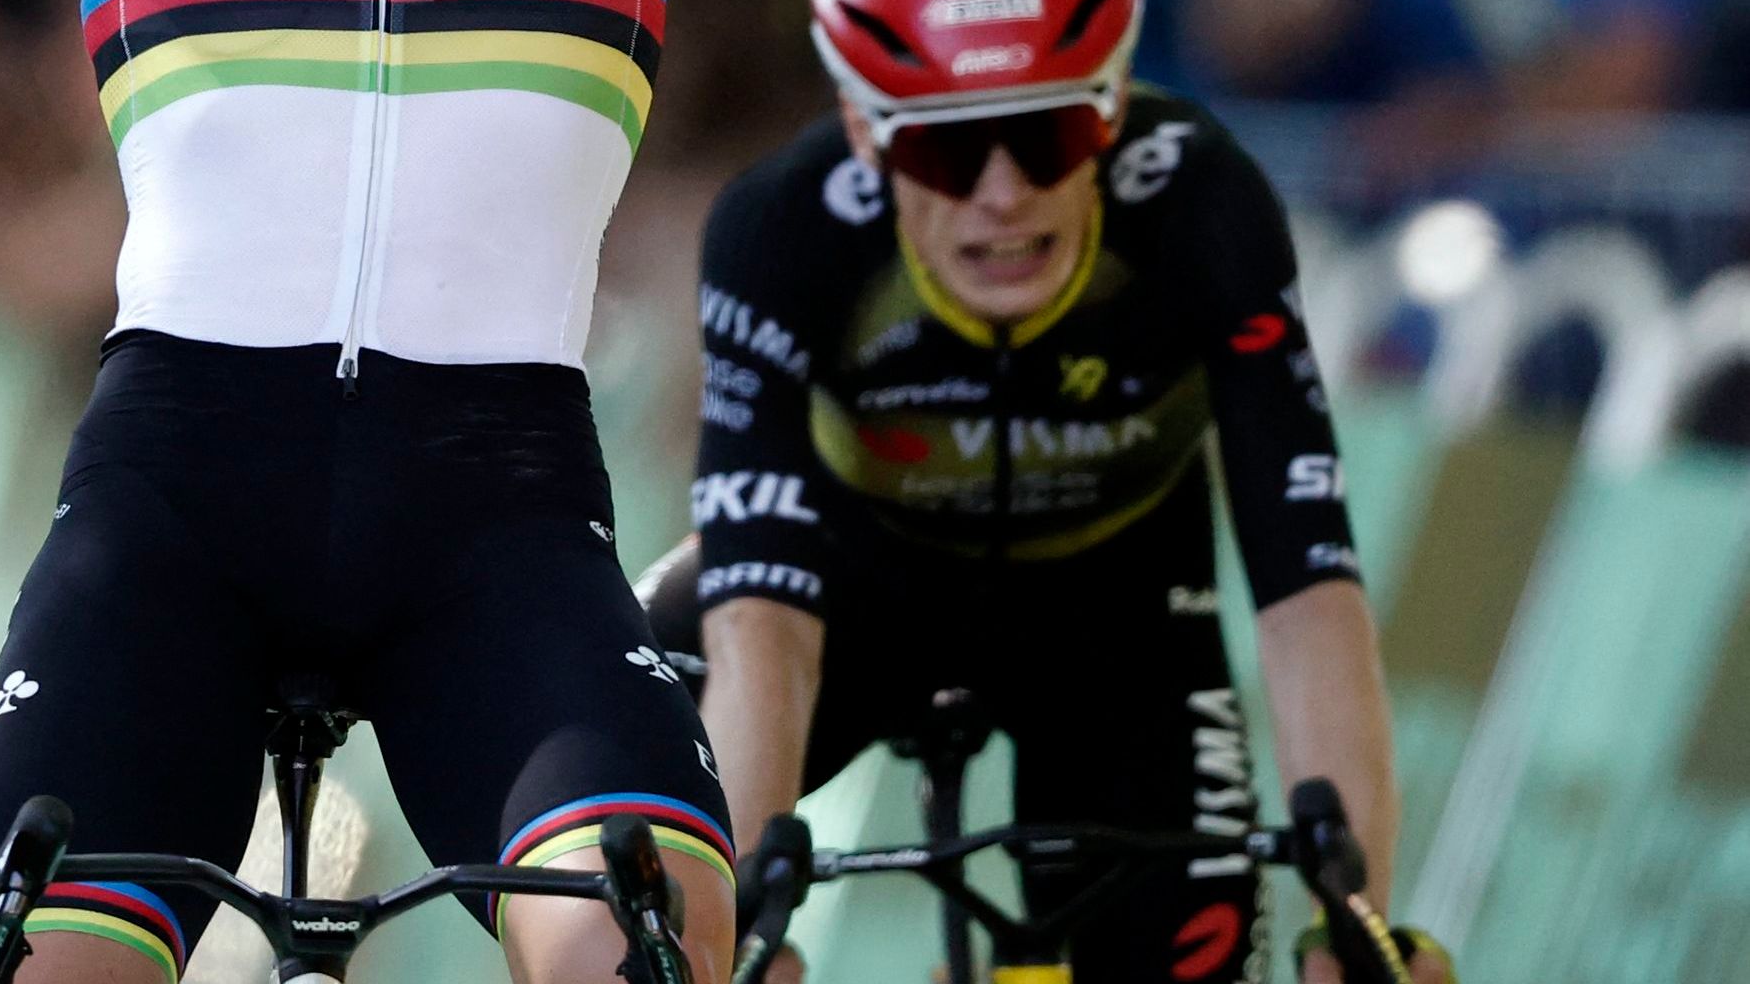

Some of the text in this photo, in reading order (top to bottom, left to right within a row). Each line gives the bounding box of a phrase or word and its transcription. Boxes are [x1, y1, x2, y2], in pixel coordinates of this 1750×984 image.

[951, 415, 1156, 459] VISMA
[697, 562, 823, 600] RAM
[291, 916, 361, 932] wahoo
